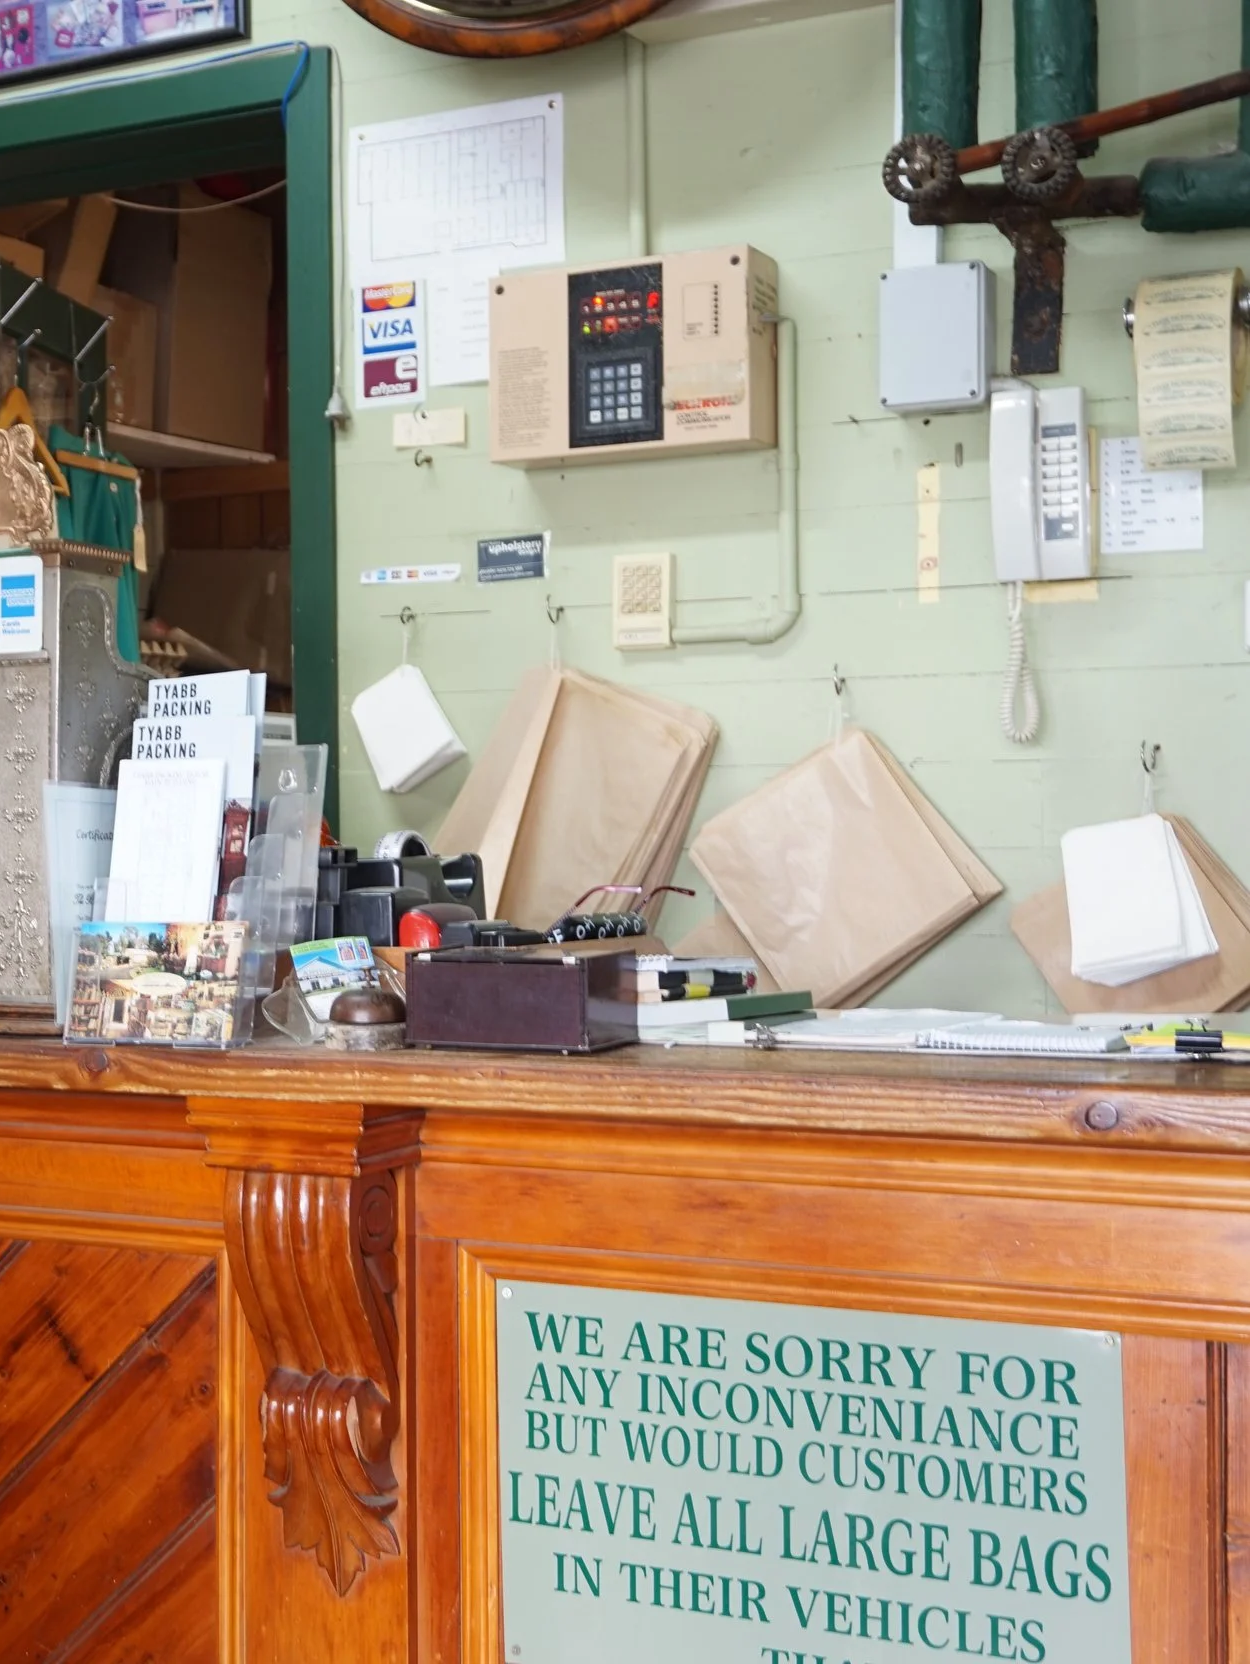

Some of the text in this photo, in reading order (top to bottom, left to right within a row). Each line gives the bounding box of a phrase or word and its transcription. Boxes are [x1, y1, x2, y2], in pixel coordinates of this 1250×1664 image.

[369, 318, 414, 340] VISA
[153, 699, 212, 718] PACKING
[154, 682, 198, 700] TYABB
[136, 742, 197, 759] PACKING
[138, 725, 182, 742] TYABB
[524, 1310, 1082, 1406] WE ARE SORRY FOR
[524, 1361, 1080, 1461] ANY INCONVENIANCE
[524, 1408, 1088, 1516] BUT WOULD CUSTOMERS
[508, 1470, 1112, 1603] LEAVE ALL LARGE BAGS
[552, 1551, 1046, 1664] IN THEIR VEHICLES
